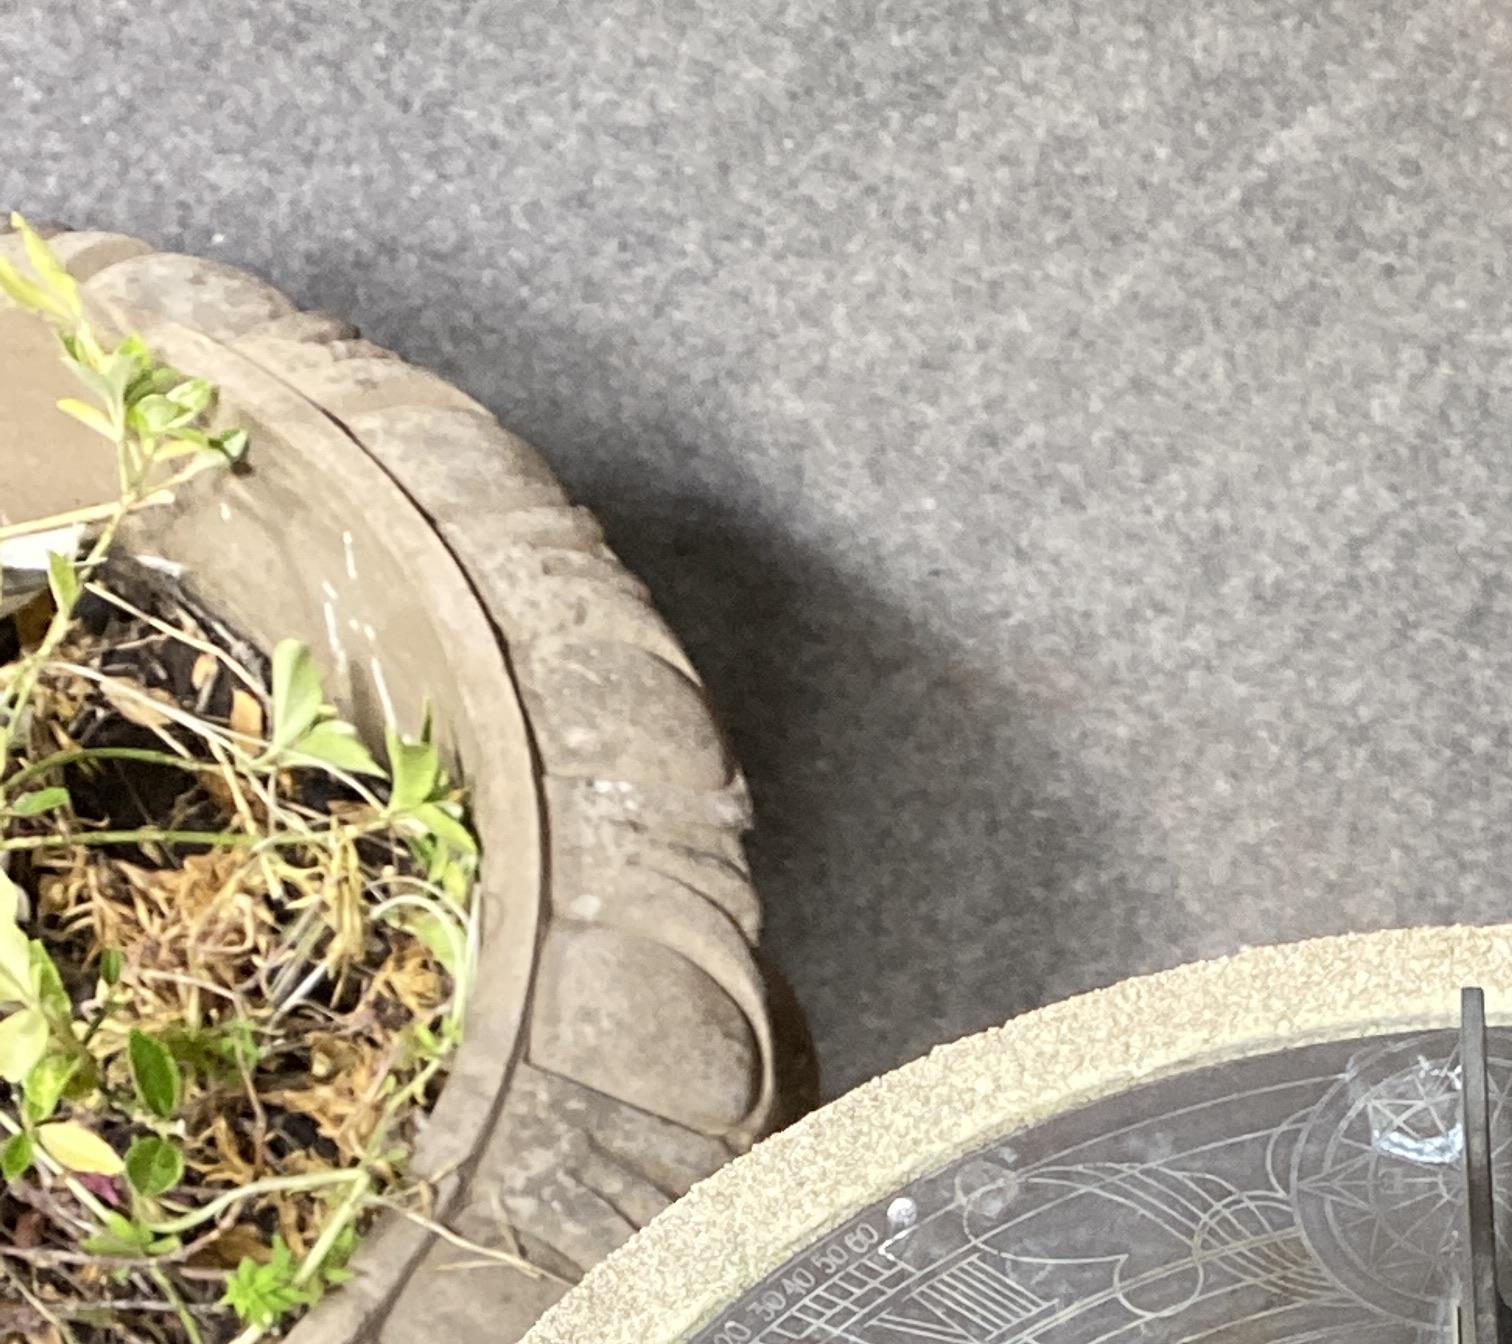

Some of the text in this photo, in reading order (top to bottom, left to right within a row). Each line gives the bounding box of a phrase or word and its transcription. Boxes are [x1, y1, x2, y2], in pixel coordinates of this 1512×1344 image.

[747, 1292, 788, 1321] 30
[780, 1269, 817, 1296] 40
[811, 1245, 849, 1273] 50
[843, 1224, 880, 1251] 60
